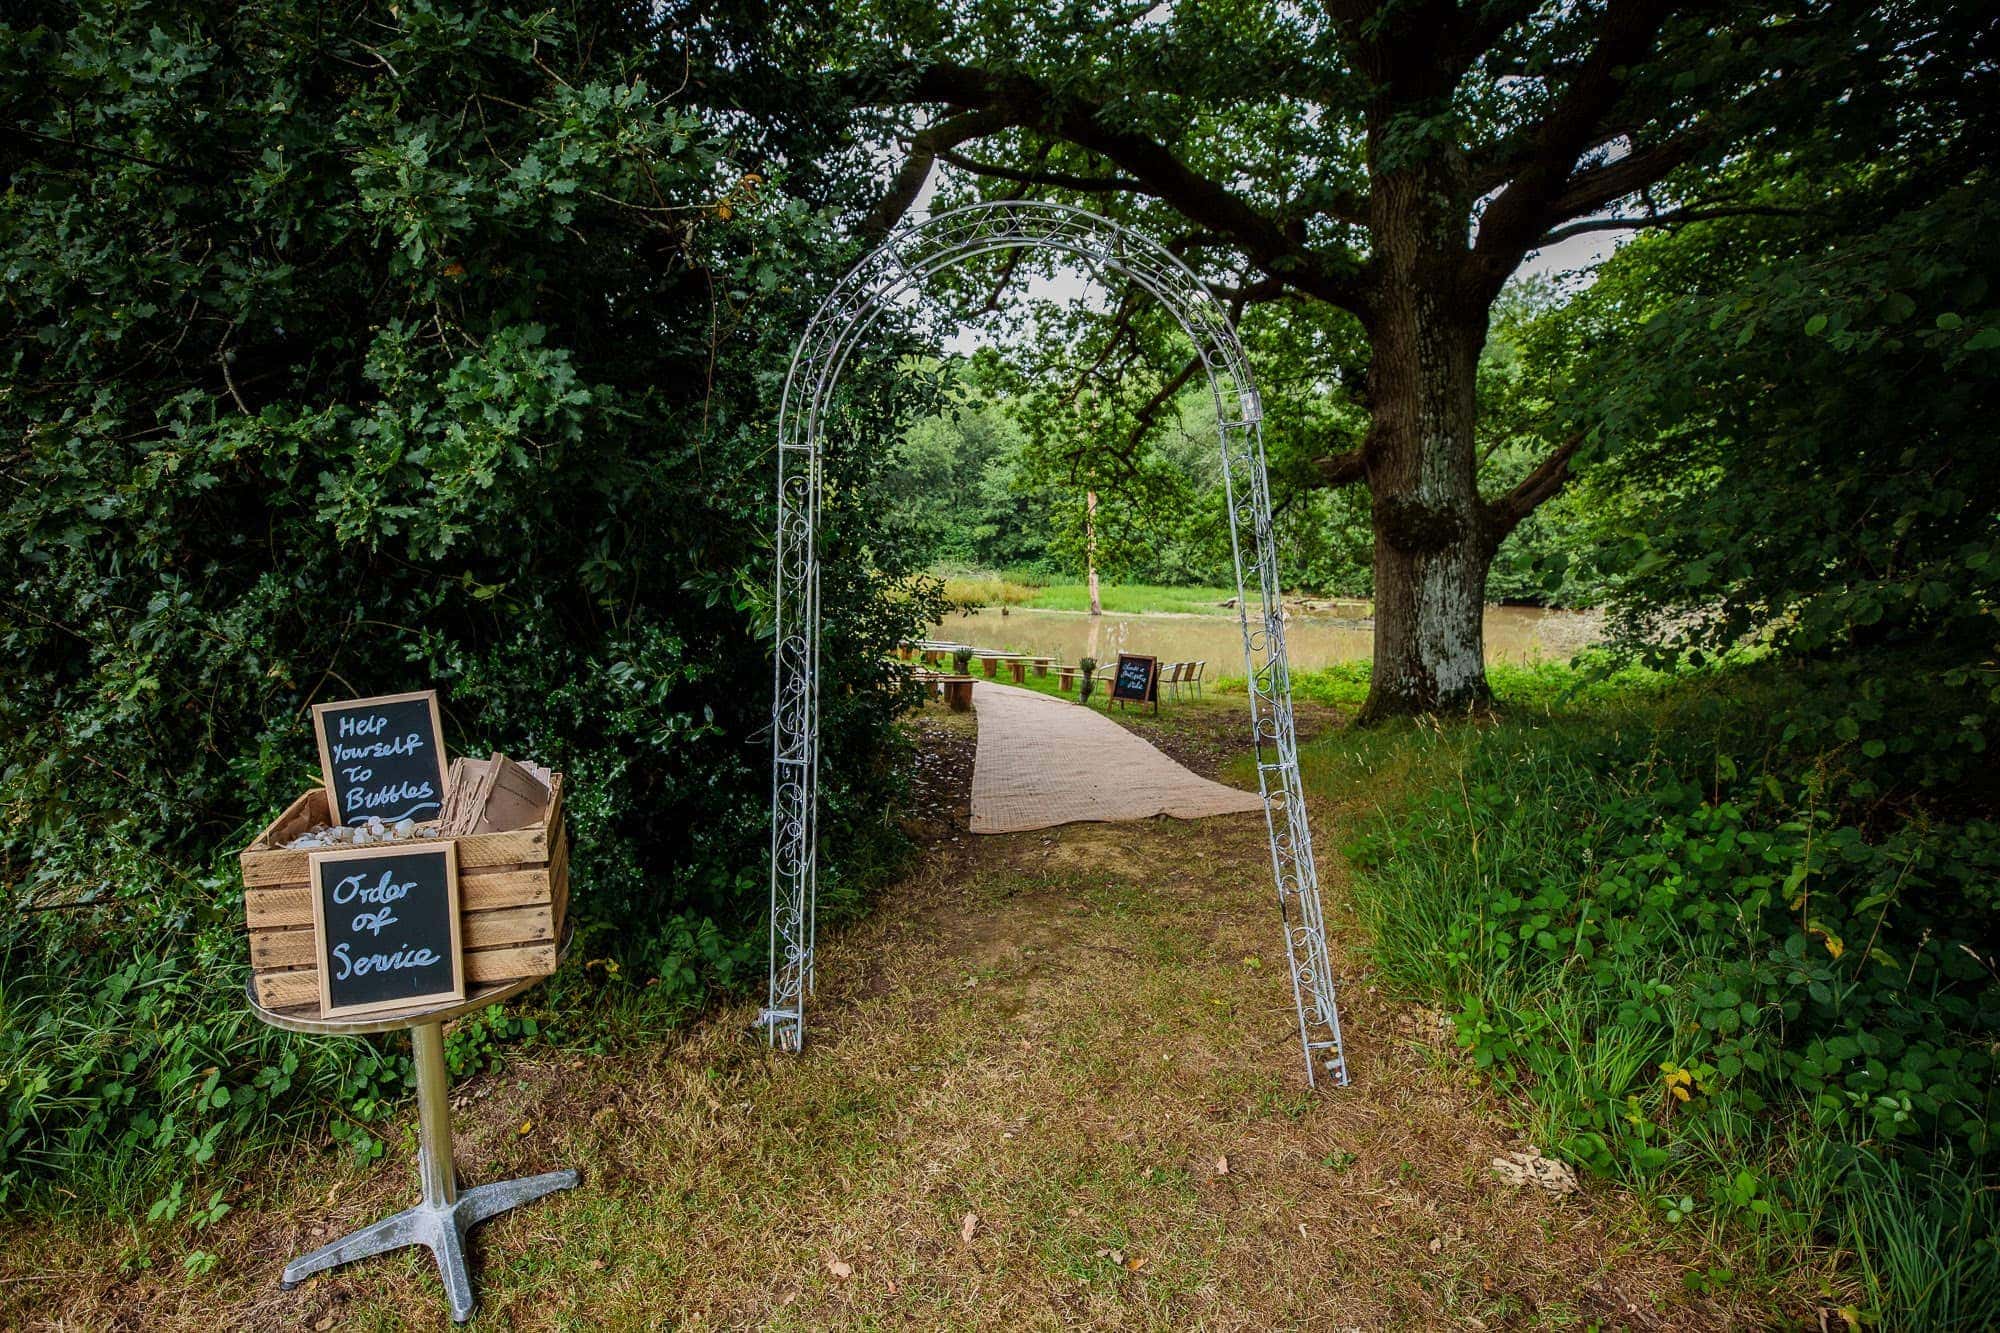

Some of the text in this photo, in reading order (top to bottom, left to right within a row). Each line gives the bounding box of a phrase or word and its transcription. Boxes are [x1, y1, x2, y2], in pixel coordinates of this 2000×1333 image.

[339, 714, 388, 738] Help
[332, 733, 424, 764] Yourself
[341, 765, 373, 783] To
[345, 780, 434, 813] Bubbles
[332, 870, 418, 905] Order
[351, 906, 399, 937] of
[332, 942, 441, 981] Service
